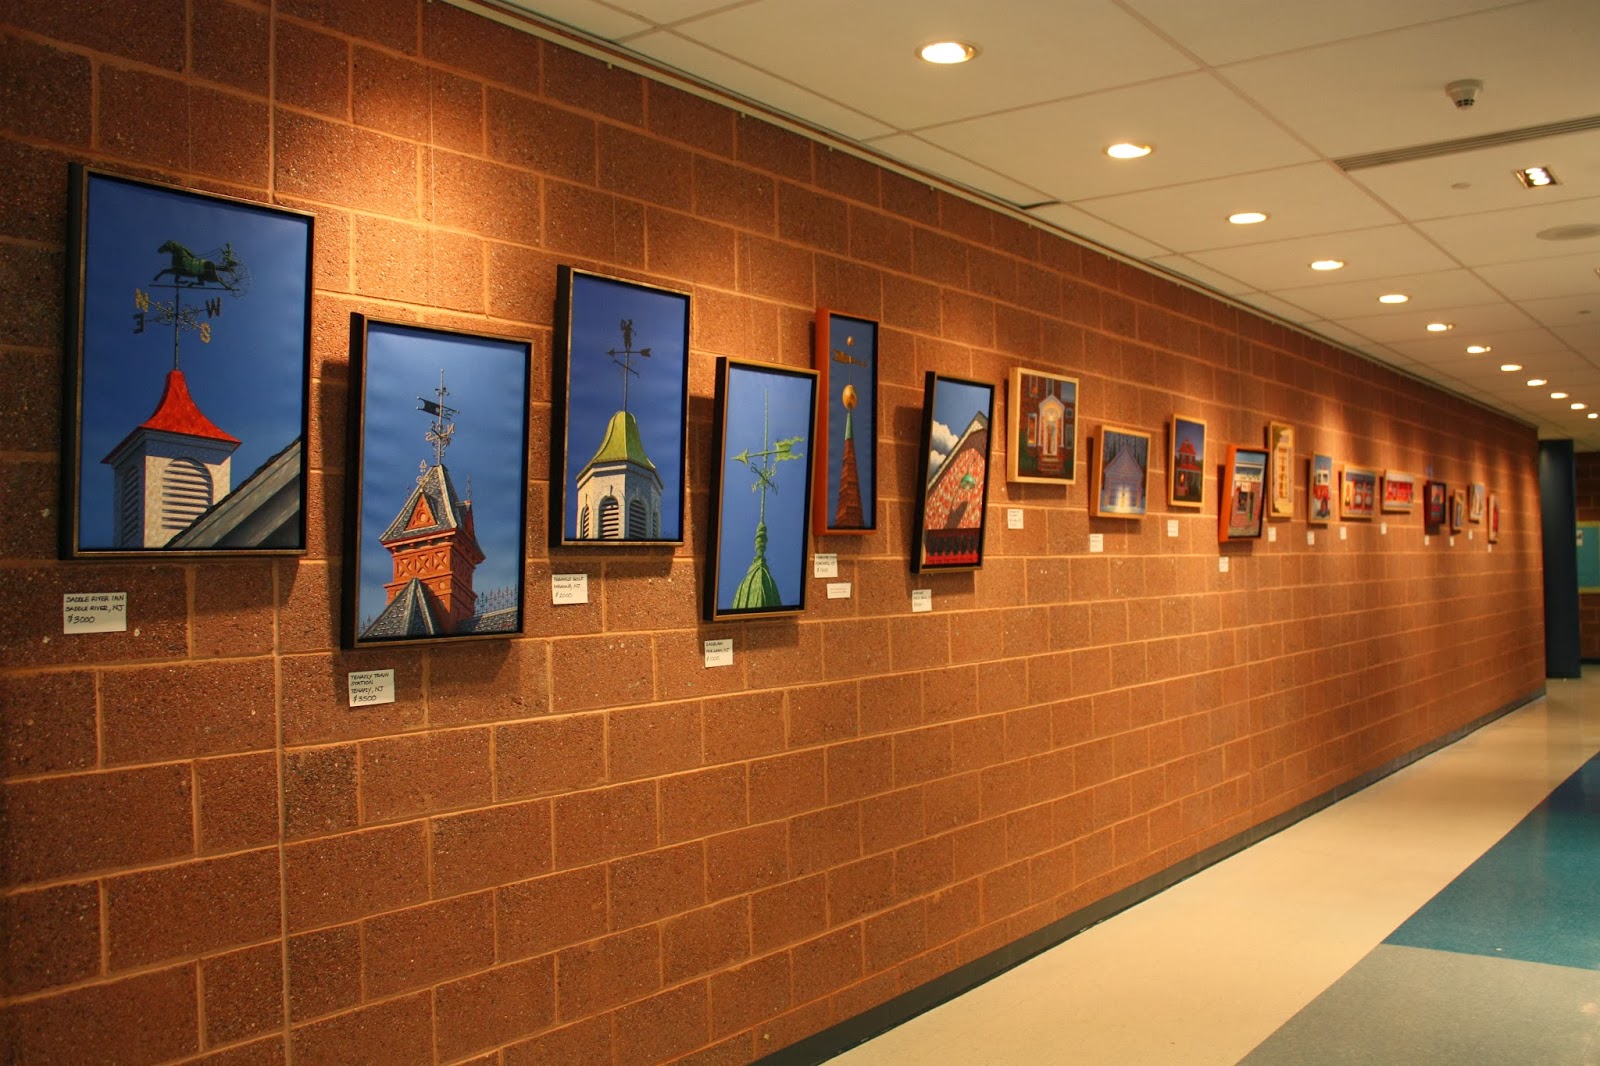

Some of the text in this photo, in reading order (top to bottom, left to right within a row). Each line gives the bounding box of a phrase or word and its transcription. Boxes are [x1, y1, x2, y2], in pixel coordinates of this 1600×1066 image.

[206, 297, 222, 318] W
[90, 605, 111, 613] RIVER,
[67, 614, 95, 624] $3000
[352, 694, 377, 704] $3500
